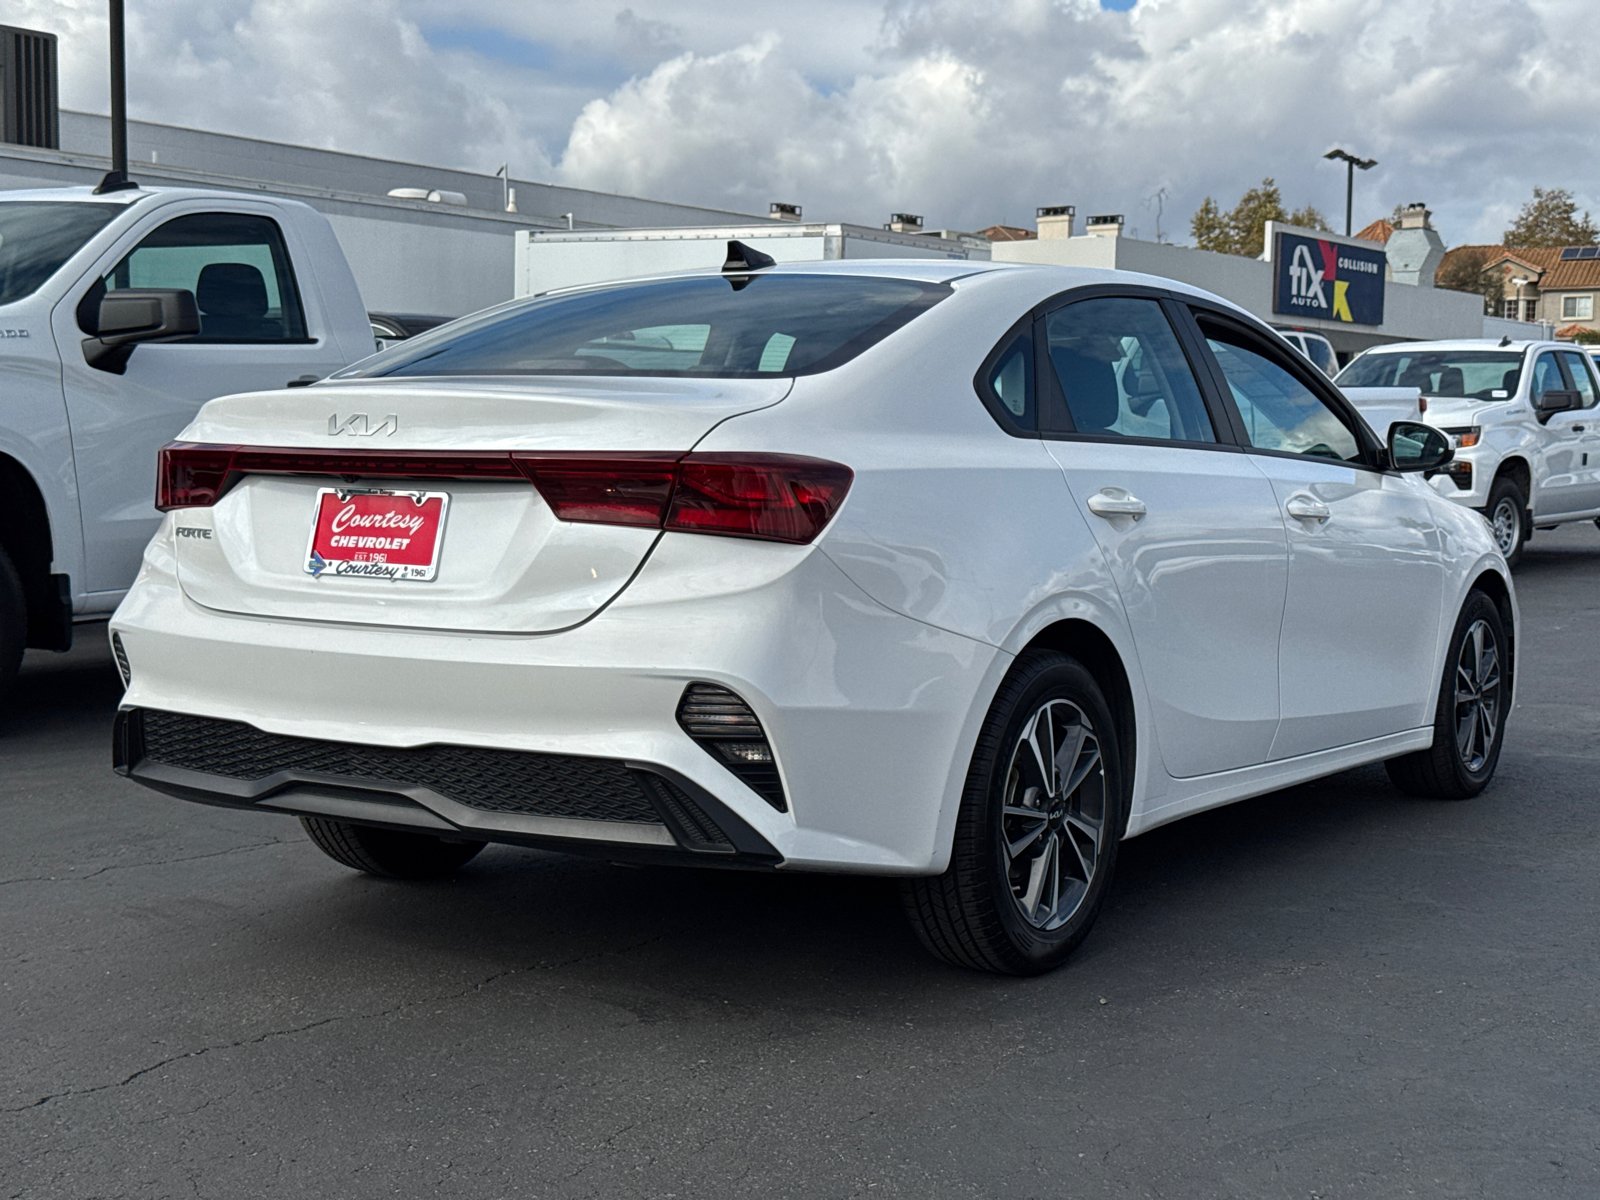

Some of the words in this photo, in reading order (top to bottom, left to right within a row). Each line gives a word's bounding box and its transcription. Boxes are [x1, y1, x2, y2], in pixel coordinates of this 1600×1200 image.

[1338, 257, 1378, 274] COLLISION
[1290, 296, 1319, 308] AUTO
[328, 413, 398, 437] KIA
[331, 504, 424, 536] Courtesy
[176, 526, 212, 539] FORTE
[330, 535, 411, 550] CHEVROLET
[369, 553, 388, 563] 1961
[336, 559, 399, 578] Courtesy
[411, 568, 426, 577] 1961
